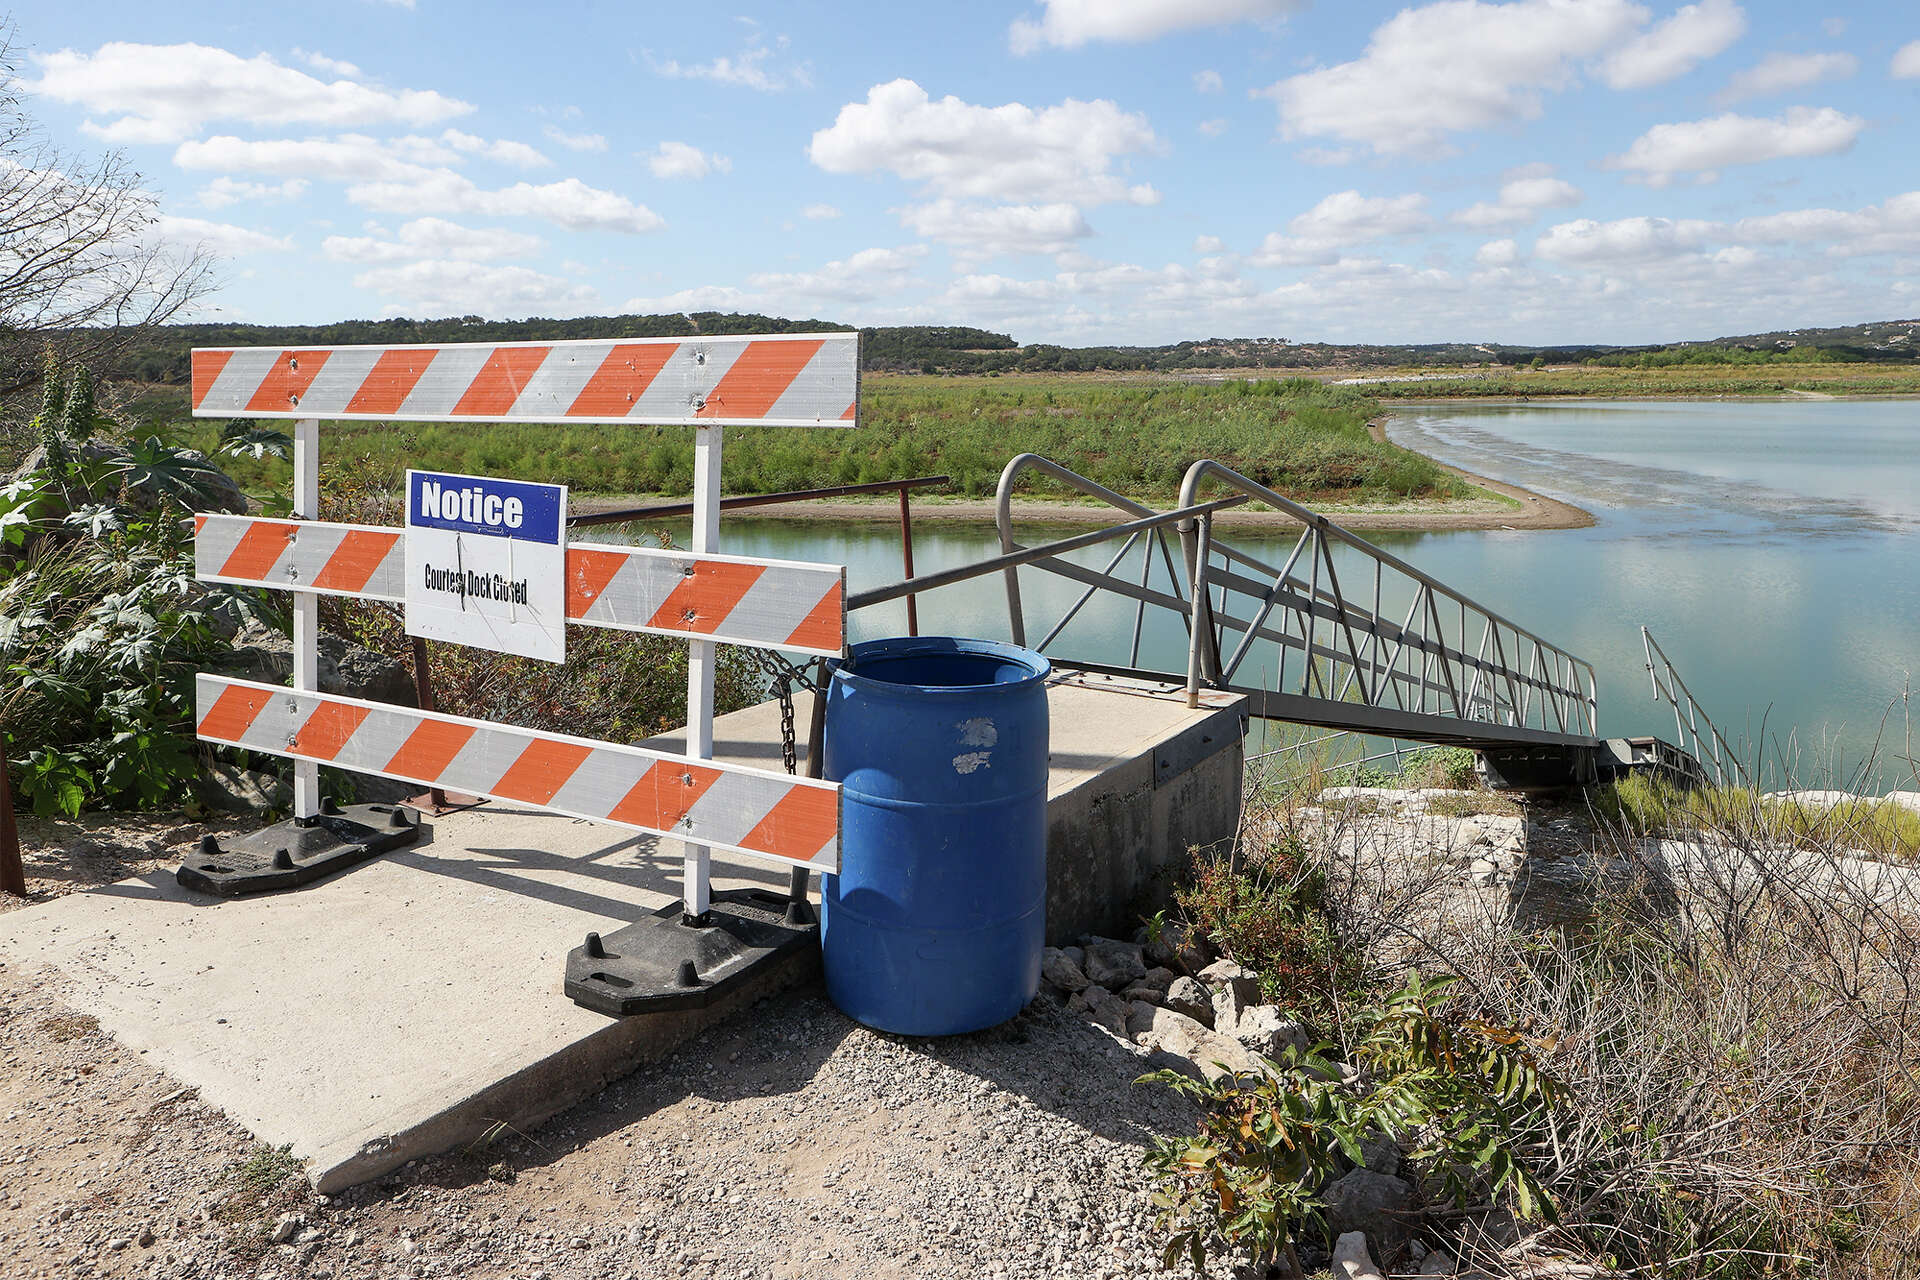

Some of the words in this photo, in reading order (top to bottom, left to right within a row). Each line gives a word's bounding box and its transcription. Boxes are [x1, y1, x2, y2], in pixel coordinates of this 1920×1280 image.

[422, 481, 523, 528] Notice
[425, 563, 466, 597] Courtesy
[468, 570, 492, 599] Dock
